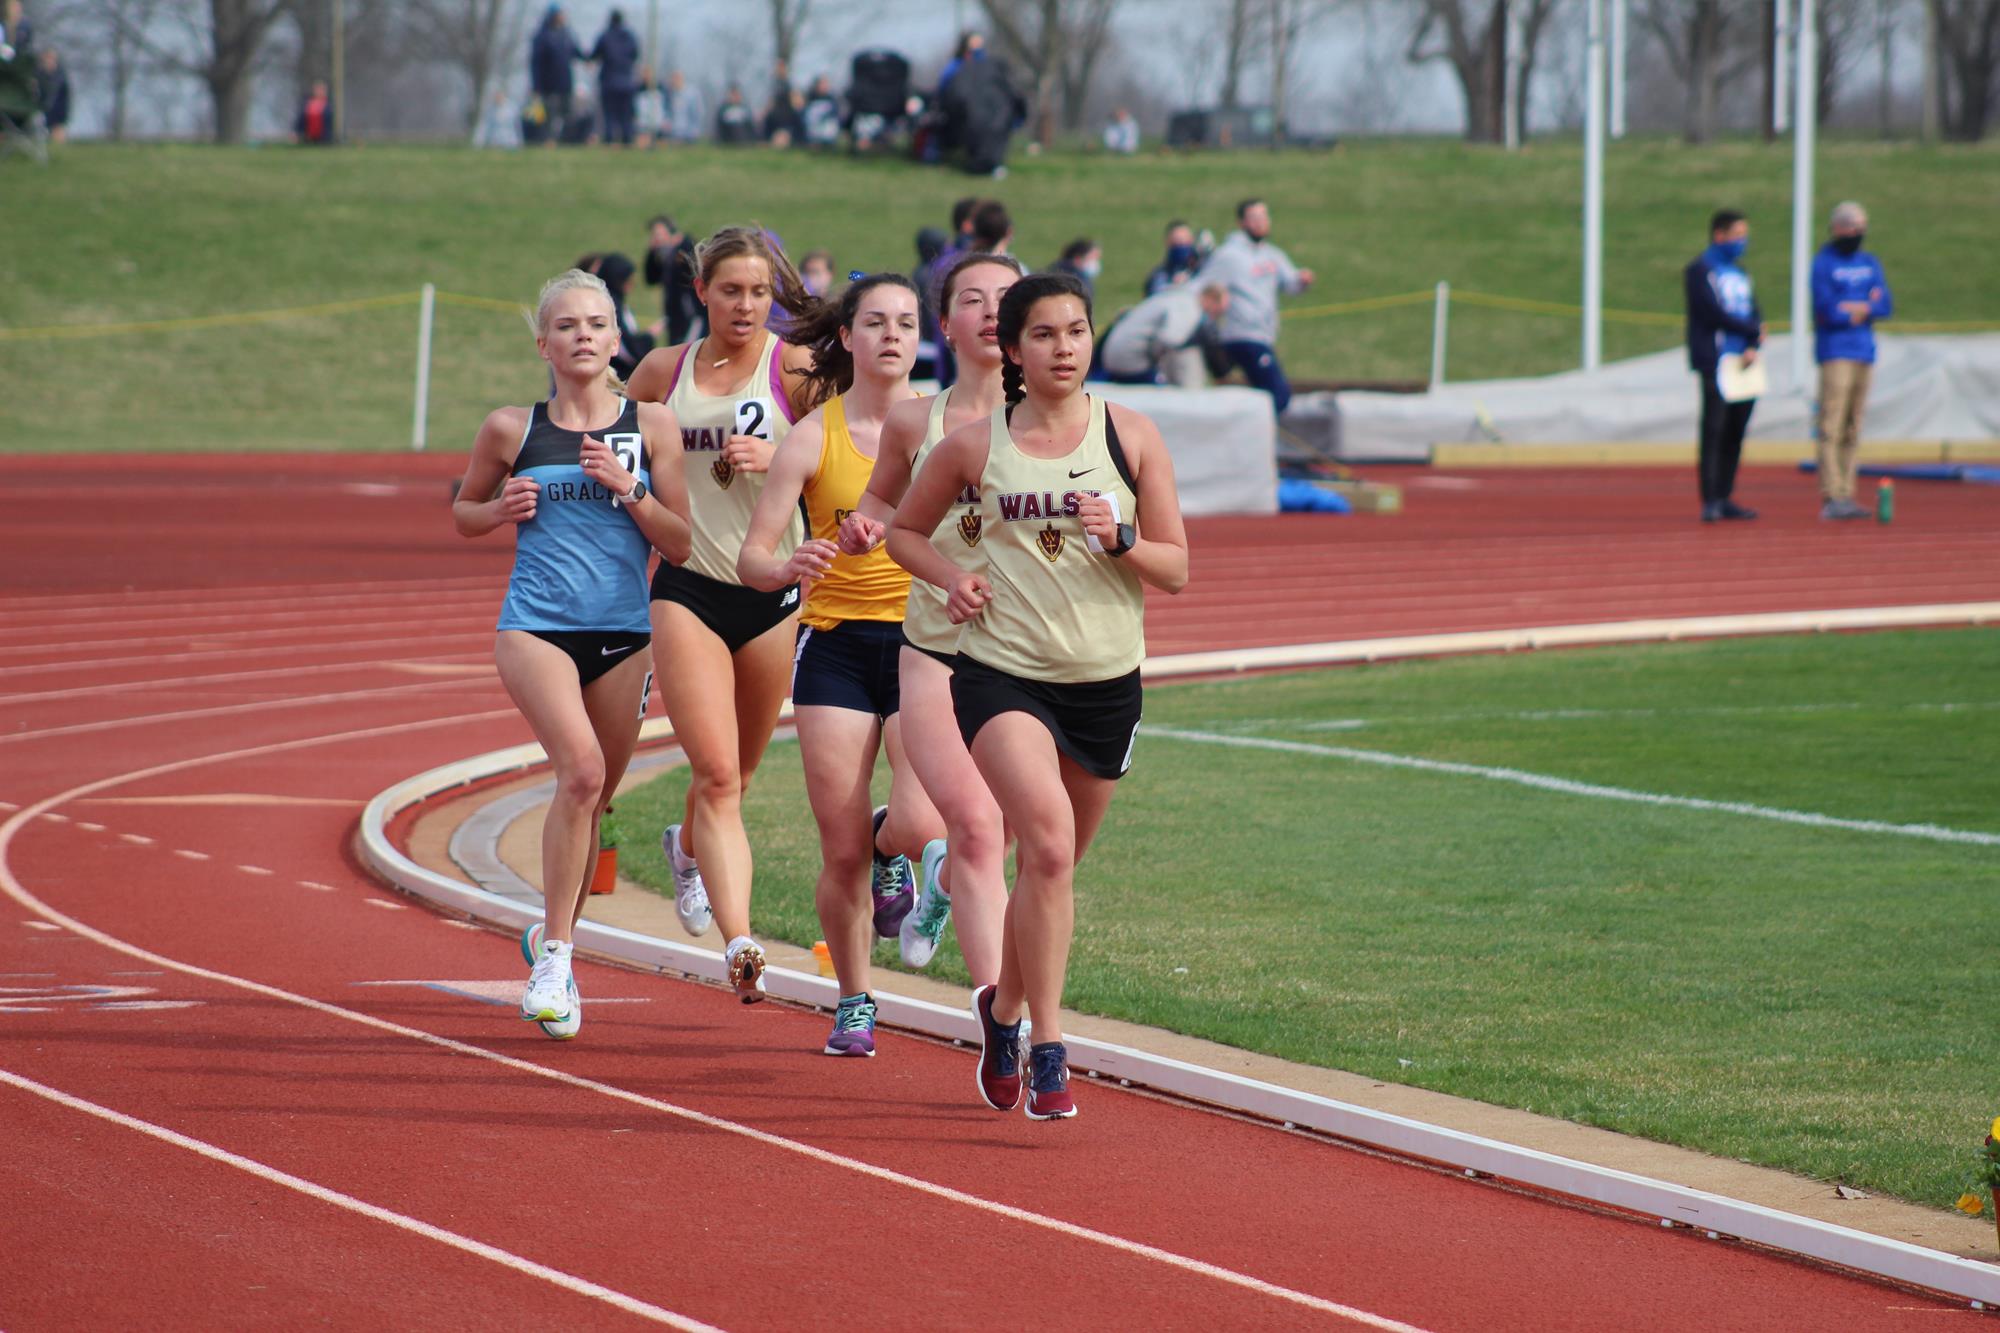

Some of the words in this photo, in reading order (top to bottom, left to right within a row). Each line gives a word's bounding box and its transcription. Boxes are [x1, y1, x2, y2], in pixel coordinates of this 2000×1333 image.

[740, 401, 767, 439] 2
[611, 436, 635, 473] 5
[680, 427, 738, 452] WAL
[998, 489, 1102, 522] WALS
